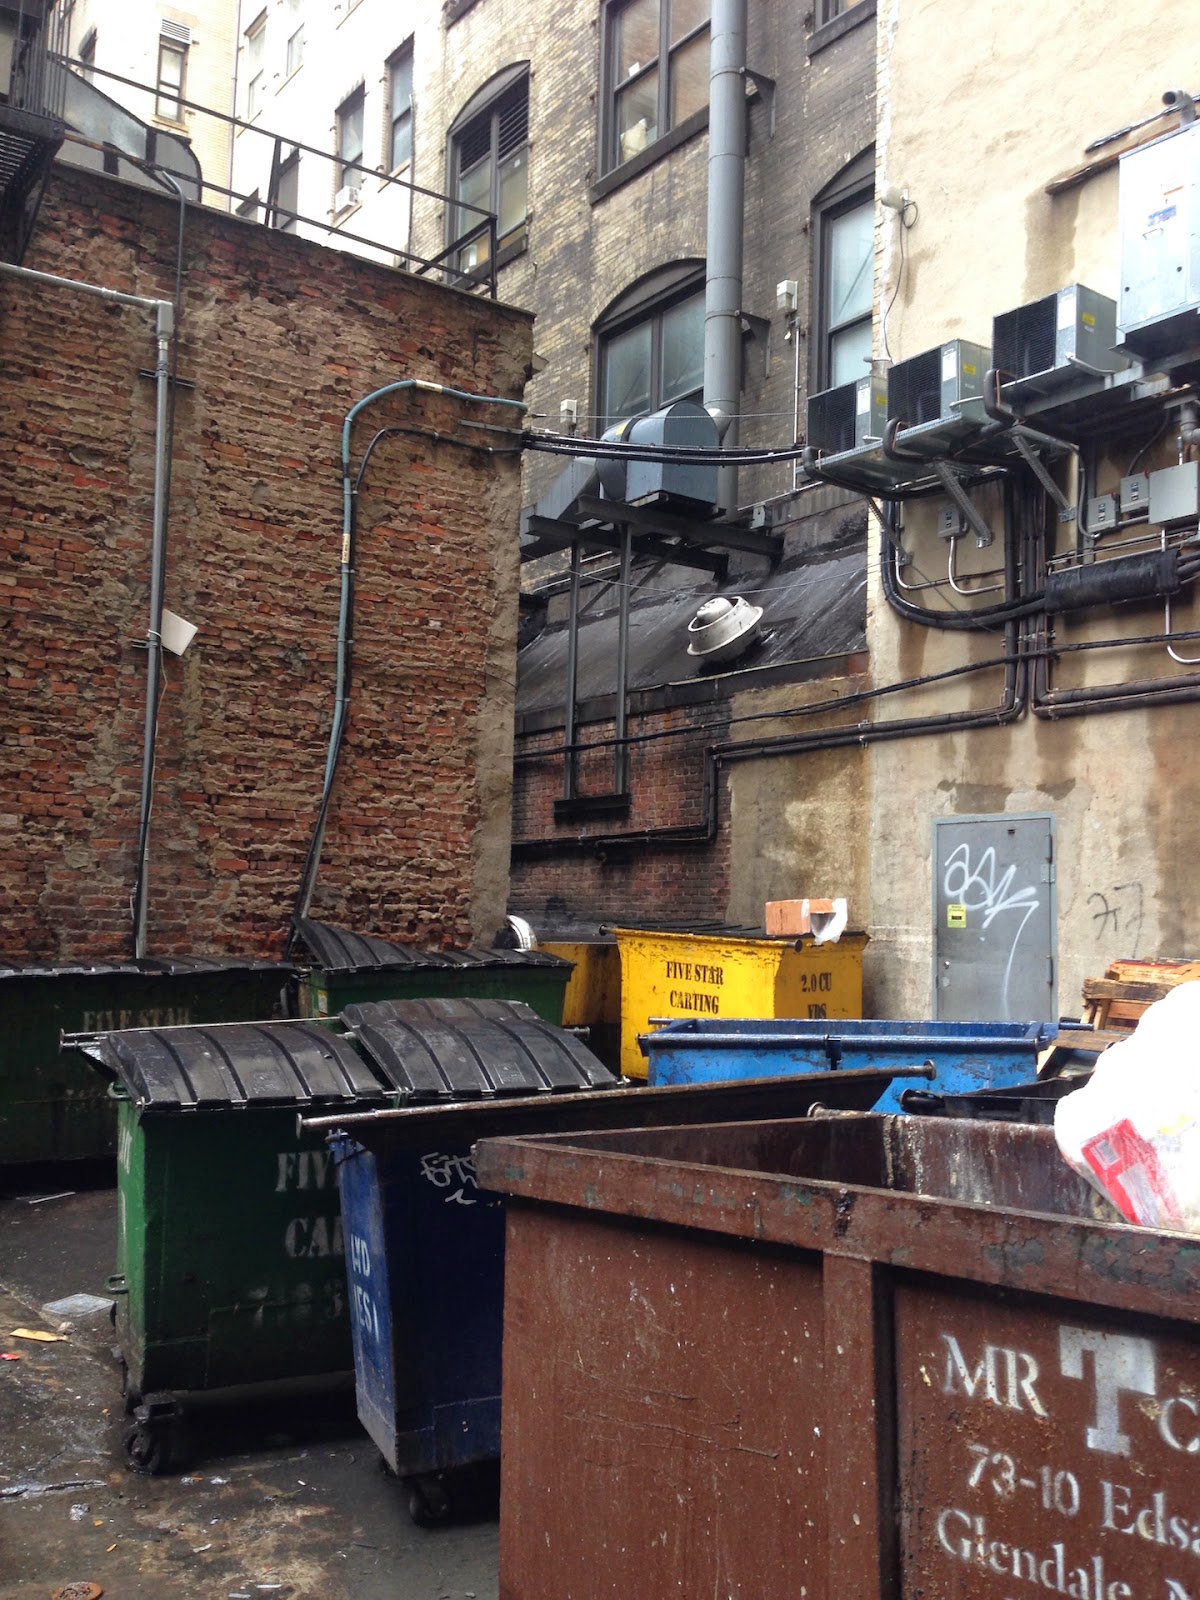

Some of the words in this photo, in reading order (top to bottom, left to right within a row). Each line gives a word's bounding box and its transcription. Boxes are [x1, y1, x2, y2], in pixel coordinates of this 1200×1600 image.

[666, 961, 692, 981] FIVE
[694, 964, 724, 986] STAR
[801, 974, 818, 993] 2.0
[819, 972, 832, 992] CU
[669, 989, 720, 1014] CARTING
[275, 1150, 341, 1192] FIV
[285, 1216, 343, 1257] CA
[941, 1332, 1049, 1417] MR
[1058, 1324, 1156, 1457] T
[967, 1442, 1081, 1517] 73-10
